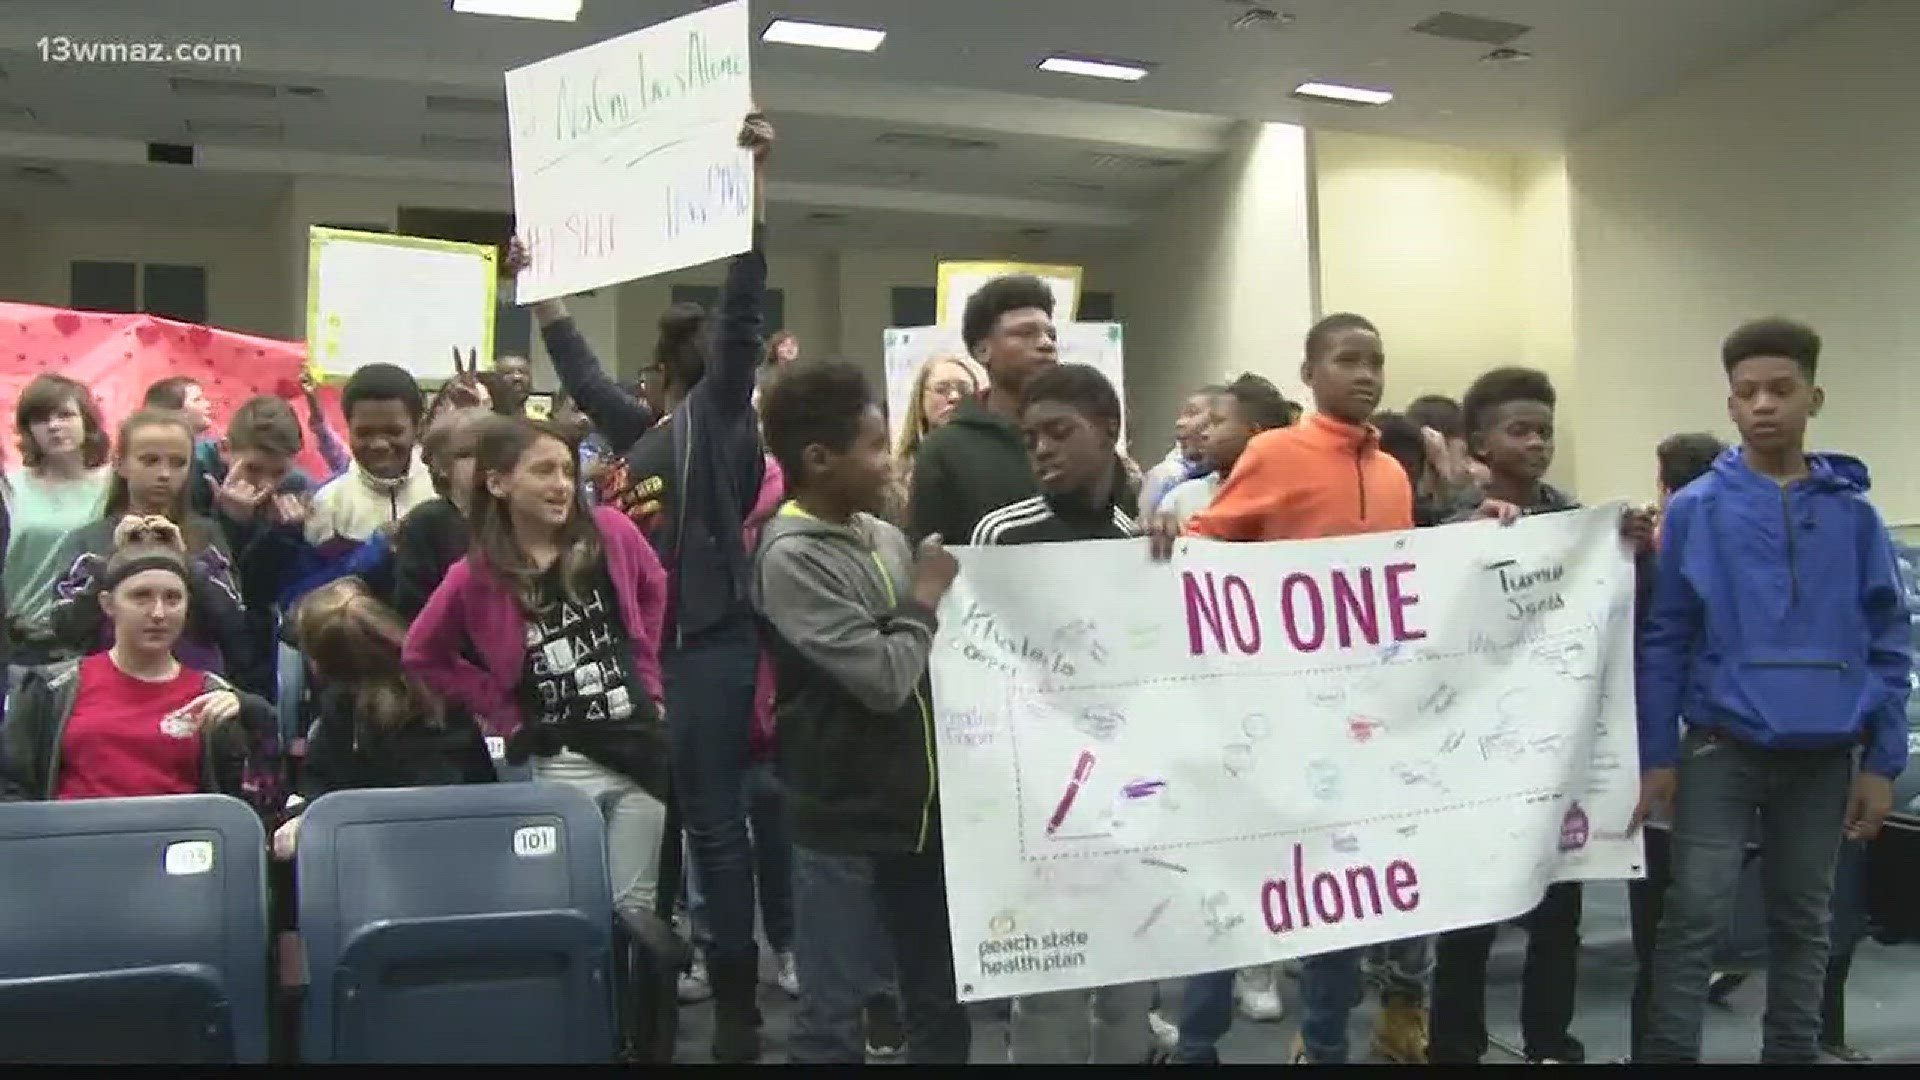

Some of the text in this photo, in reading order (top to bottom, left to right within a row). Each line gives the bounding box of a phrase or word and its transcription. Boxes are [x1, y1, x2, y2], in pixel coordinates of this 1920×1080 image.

[1182, 562, 1427, 656] NO ONE
[520, 830, 548, 851] 101
[1261, 841, 1421, 935] alone
[979, 930, 1089, 957] peach state
[979, 951, 1087, 976] health plan
